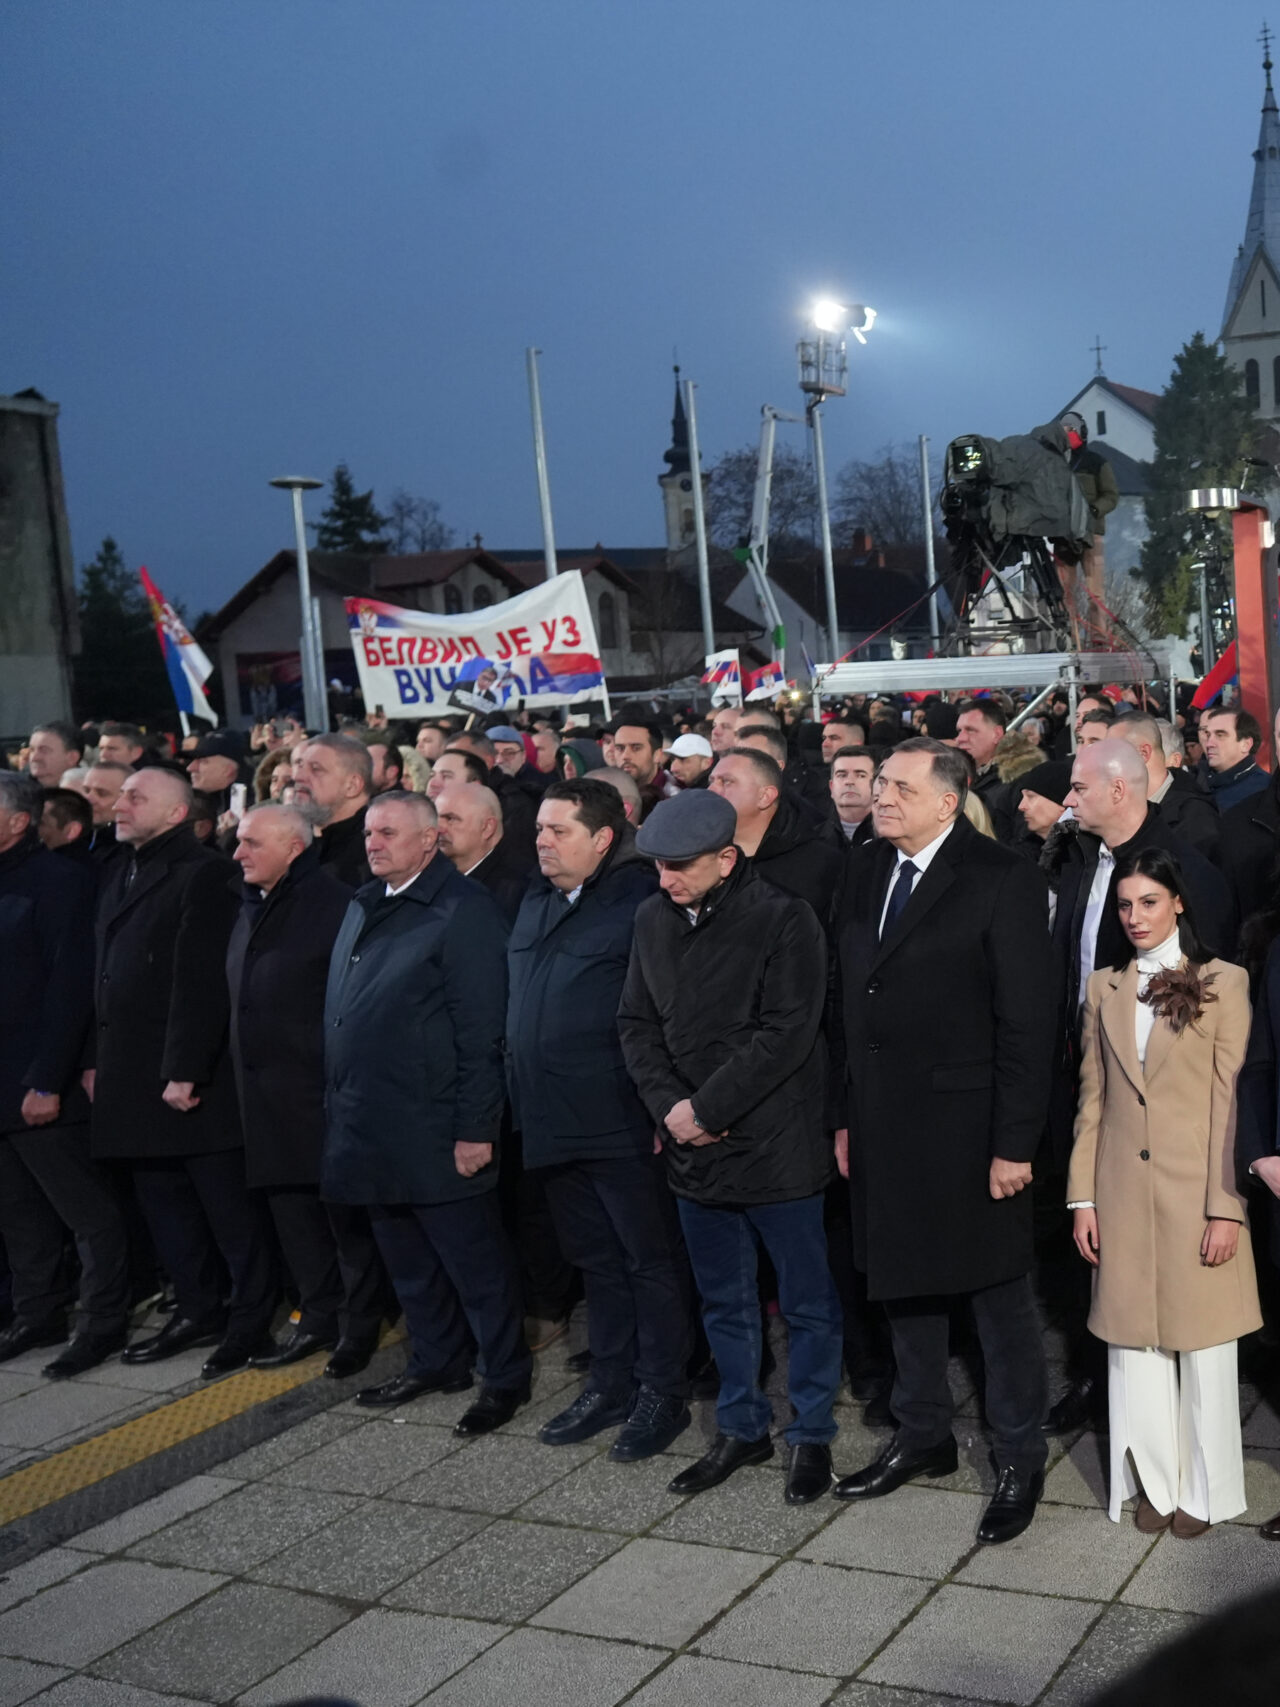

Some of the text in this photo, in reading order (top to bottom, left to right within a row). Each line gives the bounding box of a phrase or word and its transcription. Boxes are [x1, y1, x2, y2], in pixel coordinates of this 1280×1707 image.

[496, 626, 532, 660] ЈЕ
[540, 615, 581, 653] УЗ
[394, 656, 561, 704] ВУЧА
